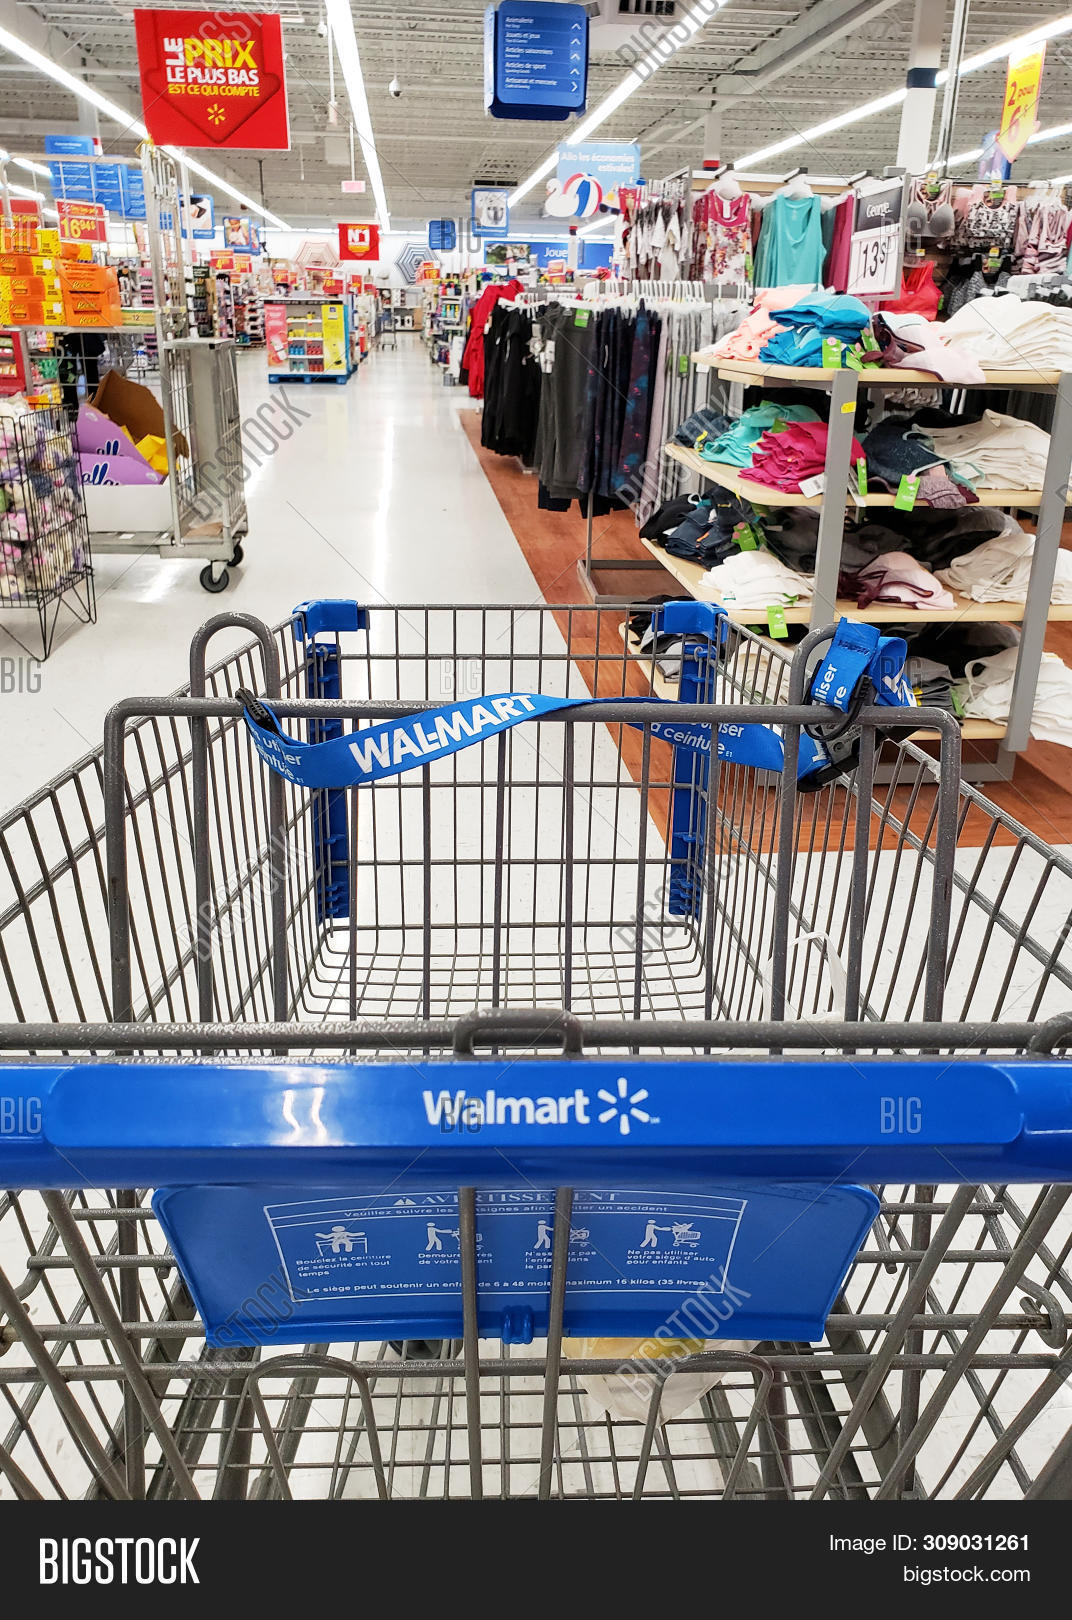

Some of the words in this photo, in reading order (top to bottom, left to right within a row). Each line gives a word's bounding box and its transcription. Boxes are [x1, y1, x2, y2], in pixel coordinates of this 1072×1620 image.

[163, 38, 185, 66] LE
[184, 38, 258, 68] PRIX
[166, 66, 186, 83] LE
[187, 67, 226, 84] PLUS
[227, 69, 259, 85] BAS
[168, 85, 186, 95] EST
[187, 85, 200, 95] CE
[200, 86, 218, 96] QUI
[219, 86, 260, 97] COMPTE
[664, 727, 725, 755] ceintue
[422, 1089, 590, 1126] Walmart
[344, 1209, 391, 1217] Veuillez
[296, 1256, 337, 1265] Bouclez
